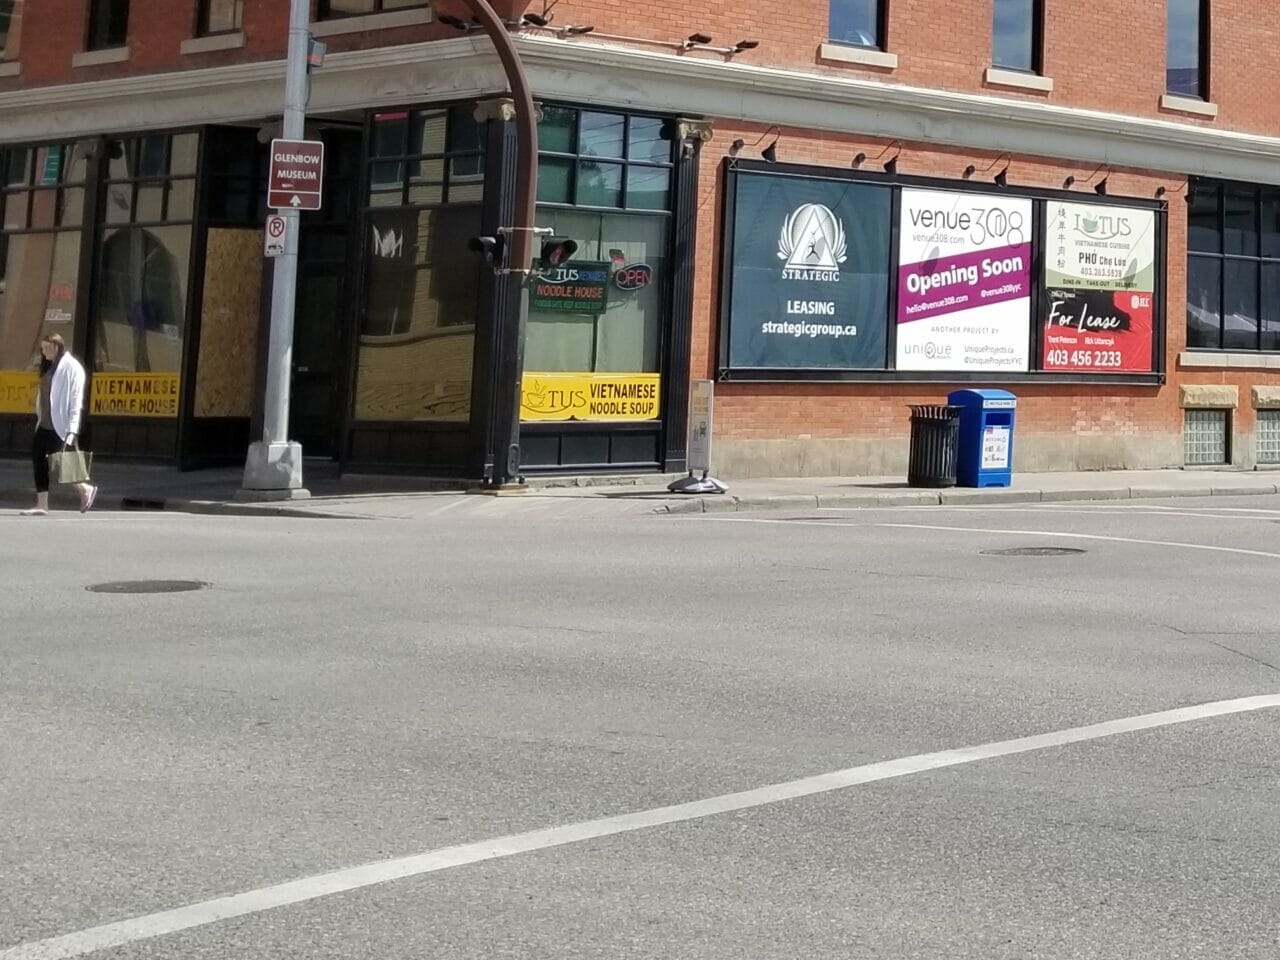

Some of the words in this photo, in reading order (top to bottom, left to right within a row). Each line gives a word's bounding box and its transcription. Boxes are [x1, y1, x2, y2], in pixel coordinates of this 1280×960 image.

[274, 153, 320, 164] GLENBOW
[277, 170, 317, 180] MUSEUM
[912, 233, 966, 244] venue308.com
[616, 269, 653, 285] OPEN
[782, 269, 840, 282] STRATEGIC
[906, 264, 978, 295] Opening
[981, 256, 1023, 277] Soon
[537, 284, 573, 297] NOODLE
[575, 286, 604, 298] HOUSE
[787, 300, 835, 315] LEASING
[905, 295, 969, 315] hello@venue308.com
[1048, 301, 1074, 330] For
[1077, 303, 1120, 333] Lease
[762, 320, 857, 338] strategicgroup.ca
[930, 326, 961, 334] ANOTHER
[963, 326, 989, 335] PROJECT
[1047, 349, 1068, 365] 403
[1071, 350, 1092, 366] 456
[1094, 351, 1122, 366] 2233
[95, 380, 177, 395] VIETNAMESE
[590, 383, 656, 399] VIETNAMESE
[589, 402, 627, 415] NOODLE
[629, 402, 654, 415] SOUP
